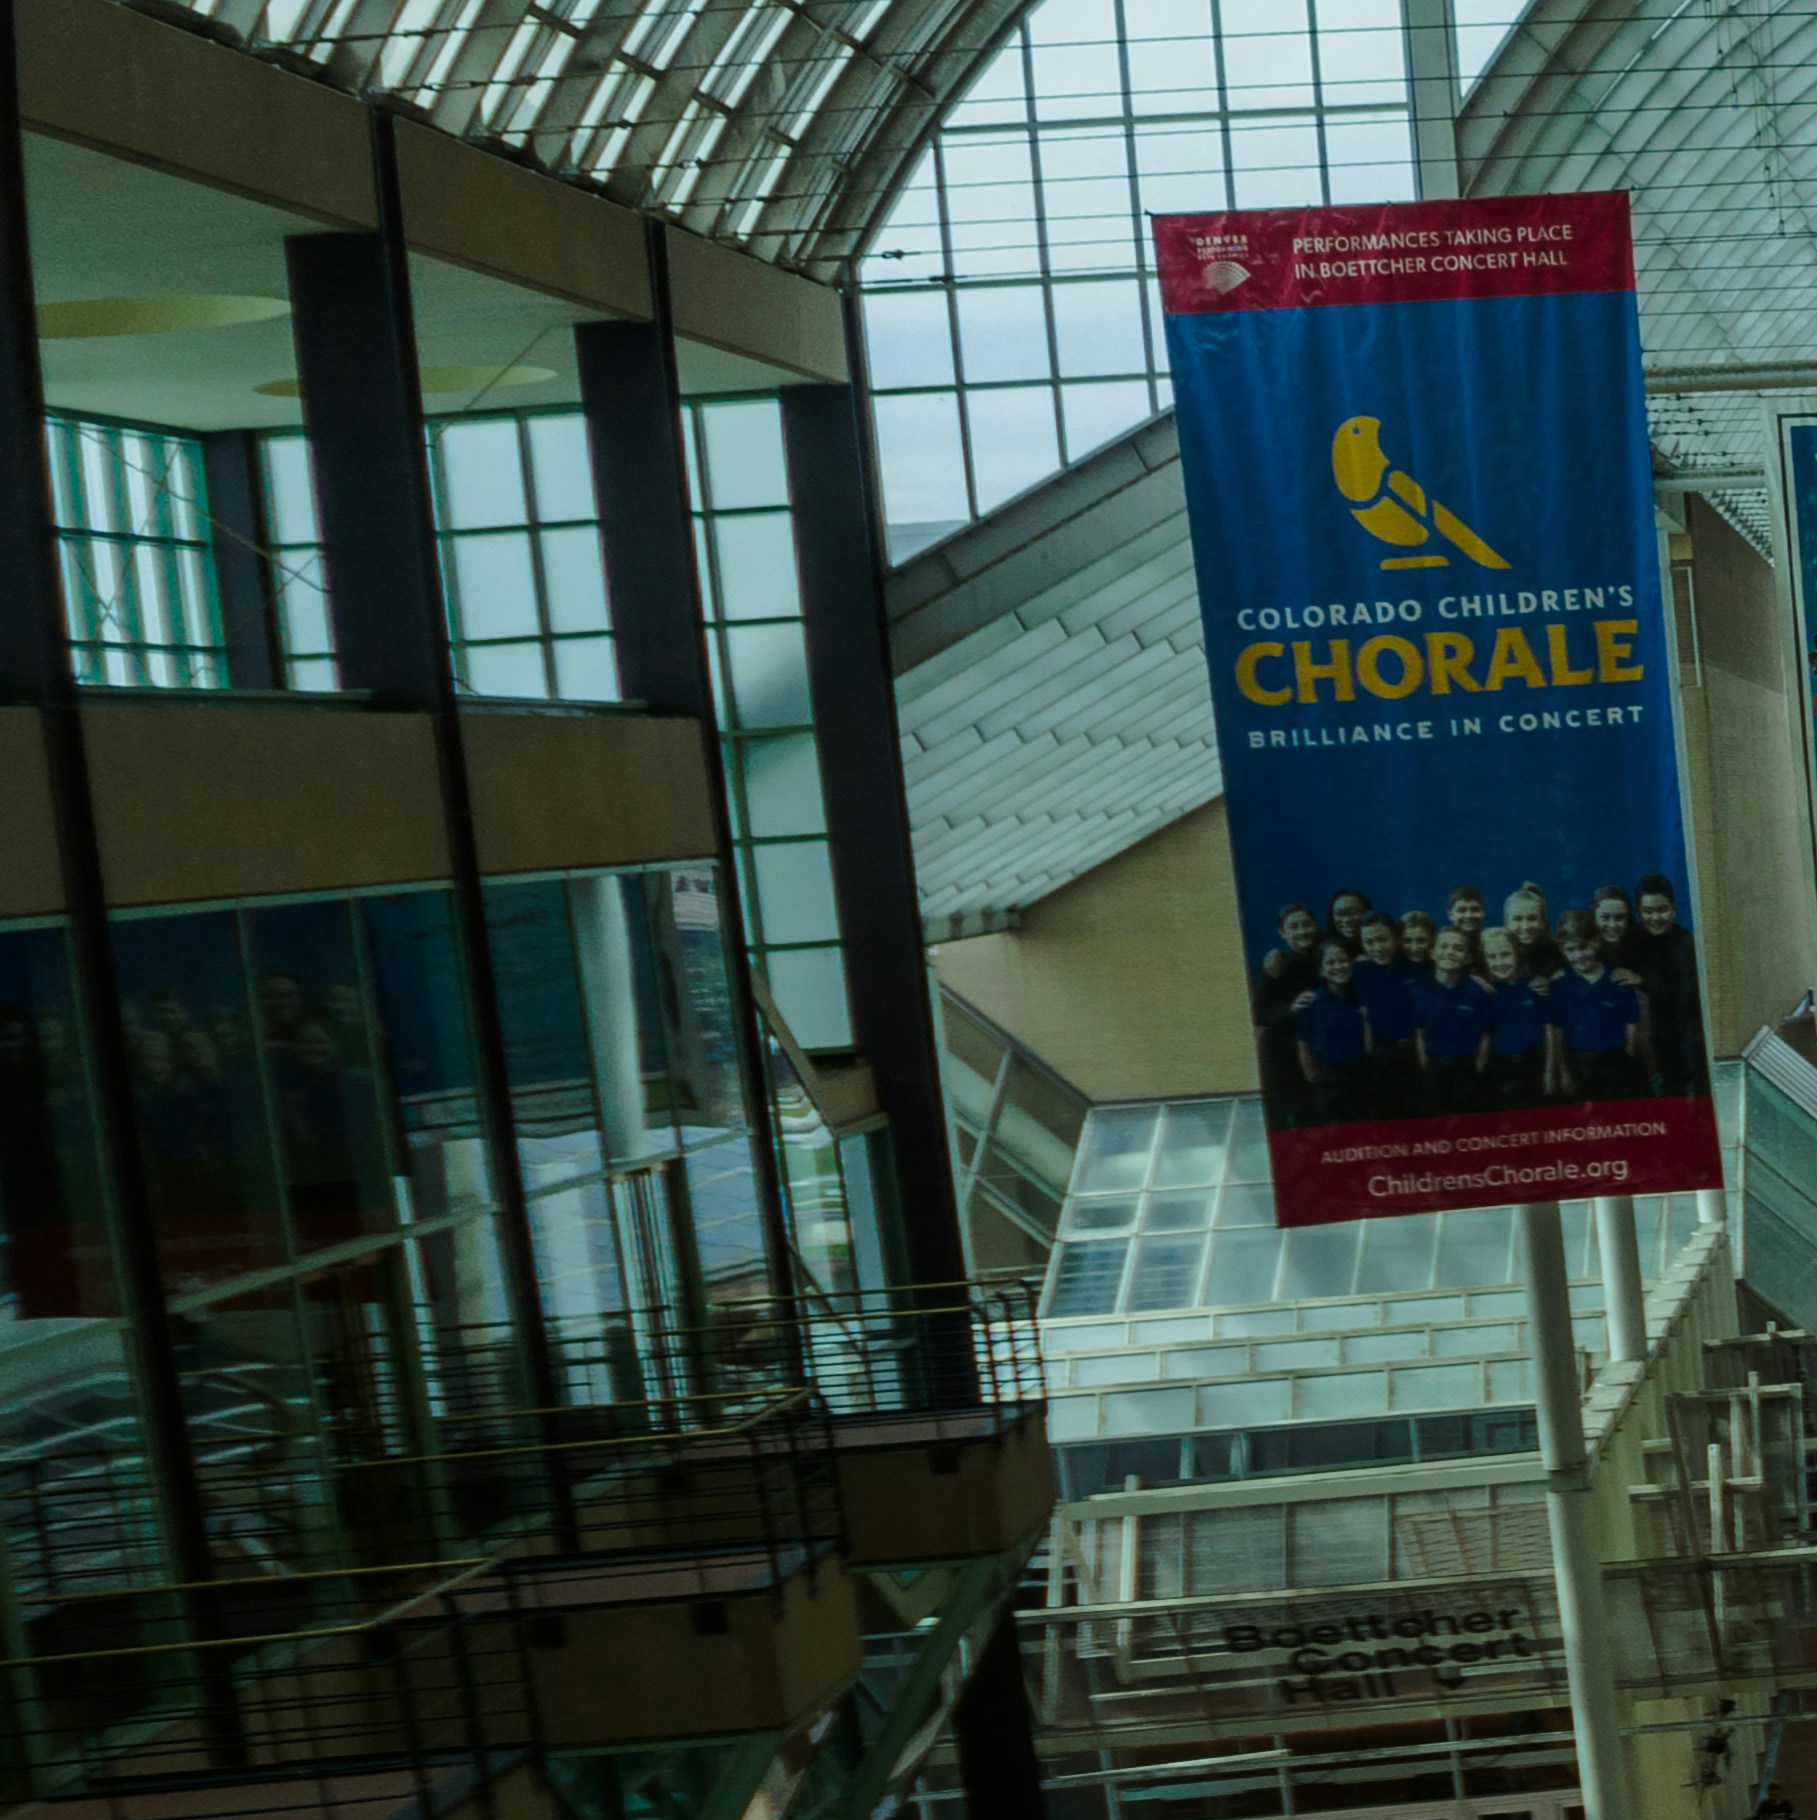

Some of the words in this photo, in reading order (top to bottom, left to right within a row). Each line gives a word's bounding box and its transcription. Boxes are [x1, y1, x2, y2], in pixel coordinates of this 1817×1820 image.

[1293, 231, 1439, 255] PERFORMANCES
[1446, 227, 1512, 247] TAKING
[1517, 224, 1573, 244] PLACE
[1295, 261, 1315, 280] IN
[1320, 256, 1427, 279] BOETTCHER
[1431, 253, 1518, 273] CONCERT
[1523, 249, 1568, 269] HALL
[1237, 598, 1422, 631] COLORADO
[1438, 585, 1633, 618] CHILDREN'S
[1234, 619, 1644, 707] CHORALE
[1248, 722, 1434, 749] BRILLIANCE
[1450, 716, 1482, 737] IN
[1499, 706, 1644, 733] CONCERT
[1321, 1143, 1409, 1165] AUDITION
[1412, 1139, 1452, 1156] AND
[1454, 1132, 1540, 1153] CONCERT
[1543, 1121, 1667, 1144] INFORMATION
[1367, 1159, 1630, 1197] ChildrensChorale.org
[1223, 1608, 1523, 1655] Boettcher
[1290, 1633, 1531, 1677] Concert
[1282, 1671, 1397, 1704] Hall
